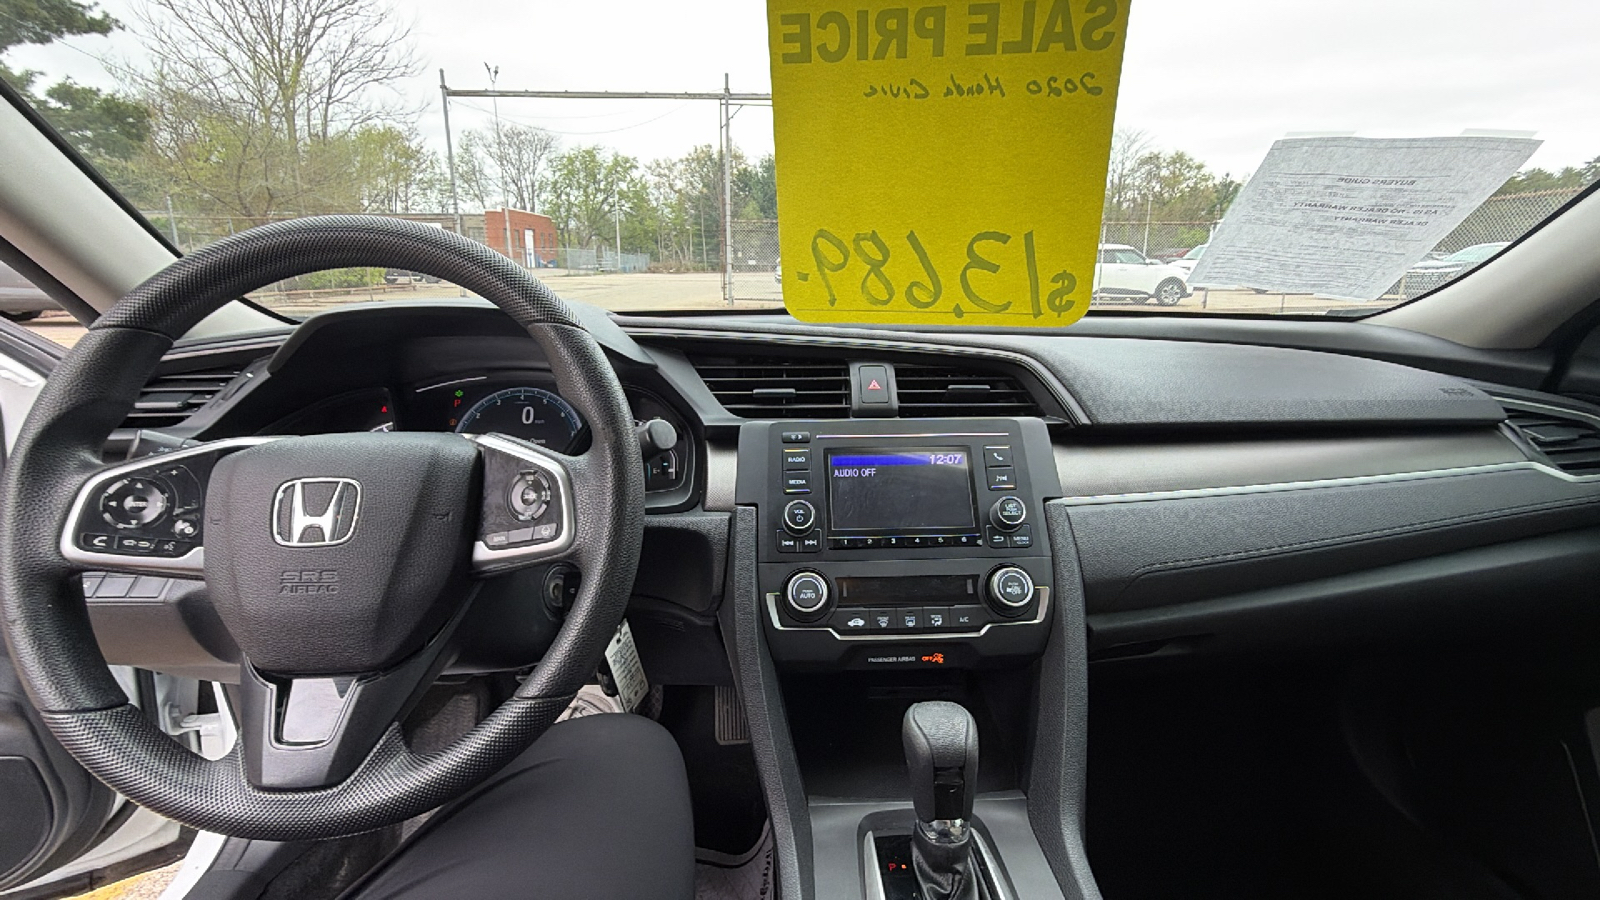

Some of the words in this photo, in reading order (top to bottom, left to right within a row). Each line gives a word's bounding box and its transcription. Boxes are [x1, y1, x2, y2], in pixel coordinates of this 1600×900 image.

[522, 406, 534, 424] 0
[929, 454, 962, 465] 12:07
[833, 469, 859, 478] AUDIO
[860, 468, 876, 477] OFF
[280, 570, 338, 583] SRS
[279, 584, 339, 594] AIRBAG
